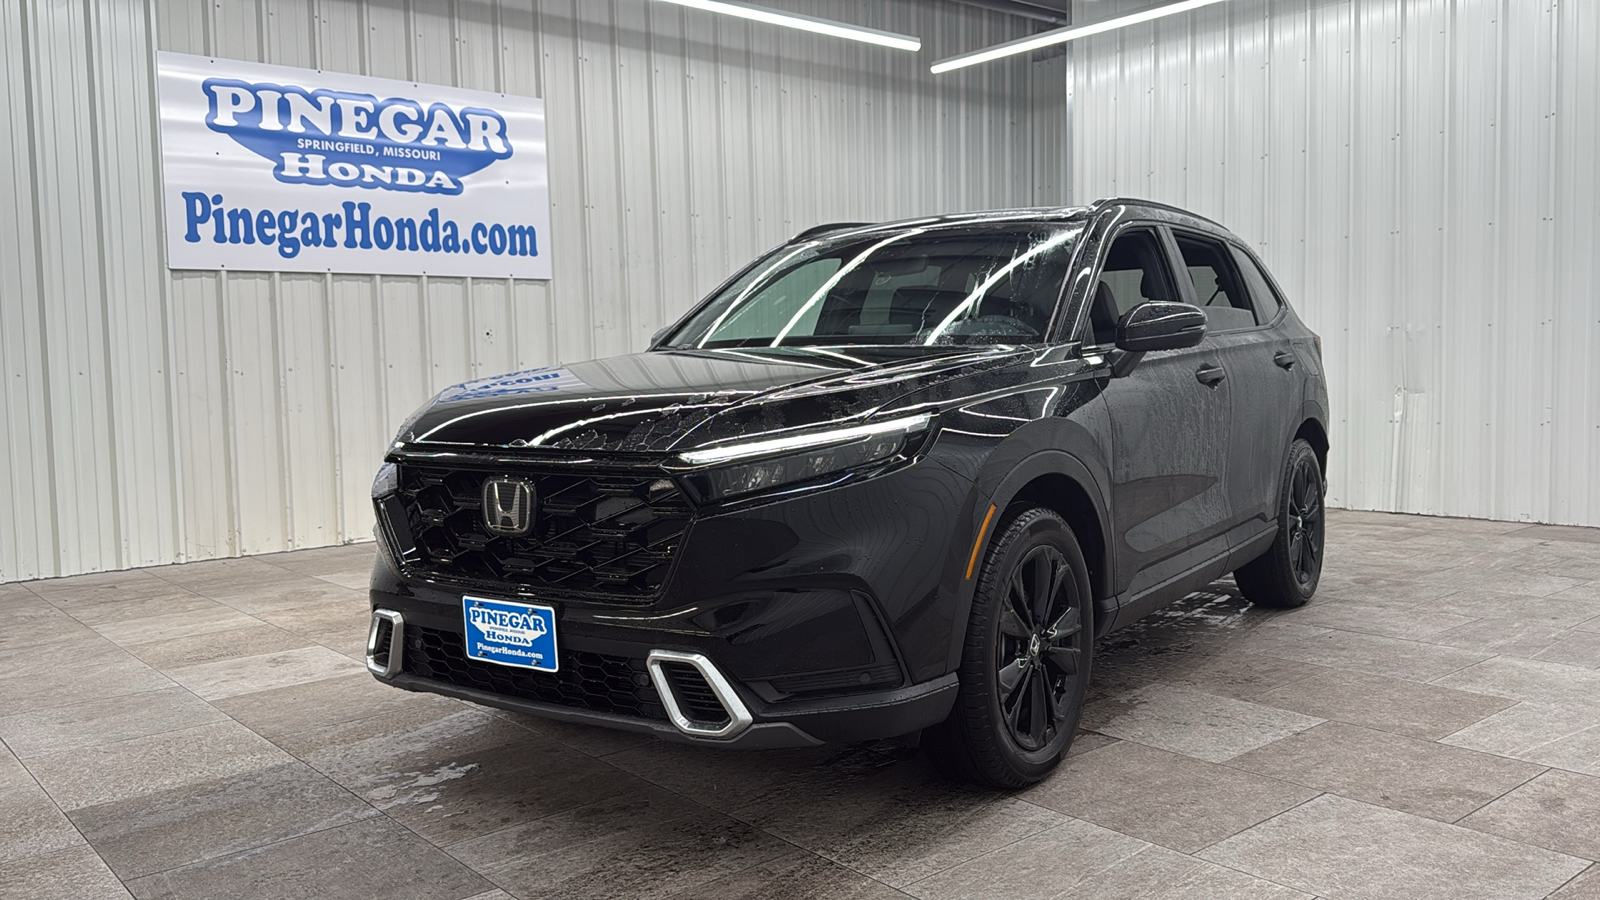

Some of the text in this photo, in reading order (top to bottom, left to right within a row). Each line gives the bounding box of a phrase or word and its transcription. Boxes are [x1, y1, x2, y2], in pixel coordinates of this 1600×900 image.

[210, 85, 508, 154] PINEGAR
[297, 138, 441, 161] SPRINGFIELD, MISSOURI
[280, 152, 457, 189] HONDA
[181, 191, 539, 258] PinegarHonda.com
[471, 609, 545, 632] PINEGAR
[486, 630, 531, 645] HONDA
[476, 642, 543, 659] PinegarHonda.com
